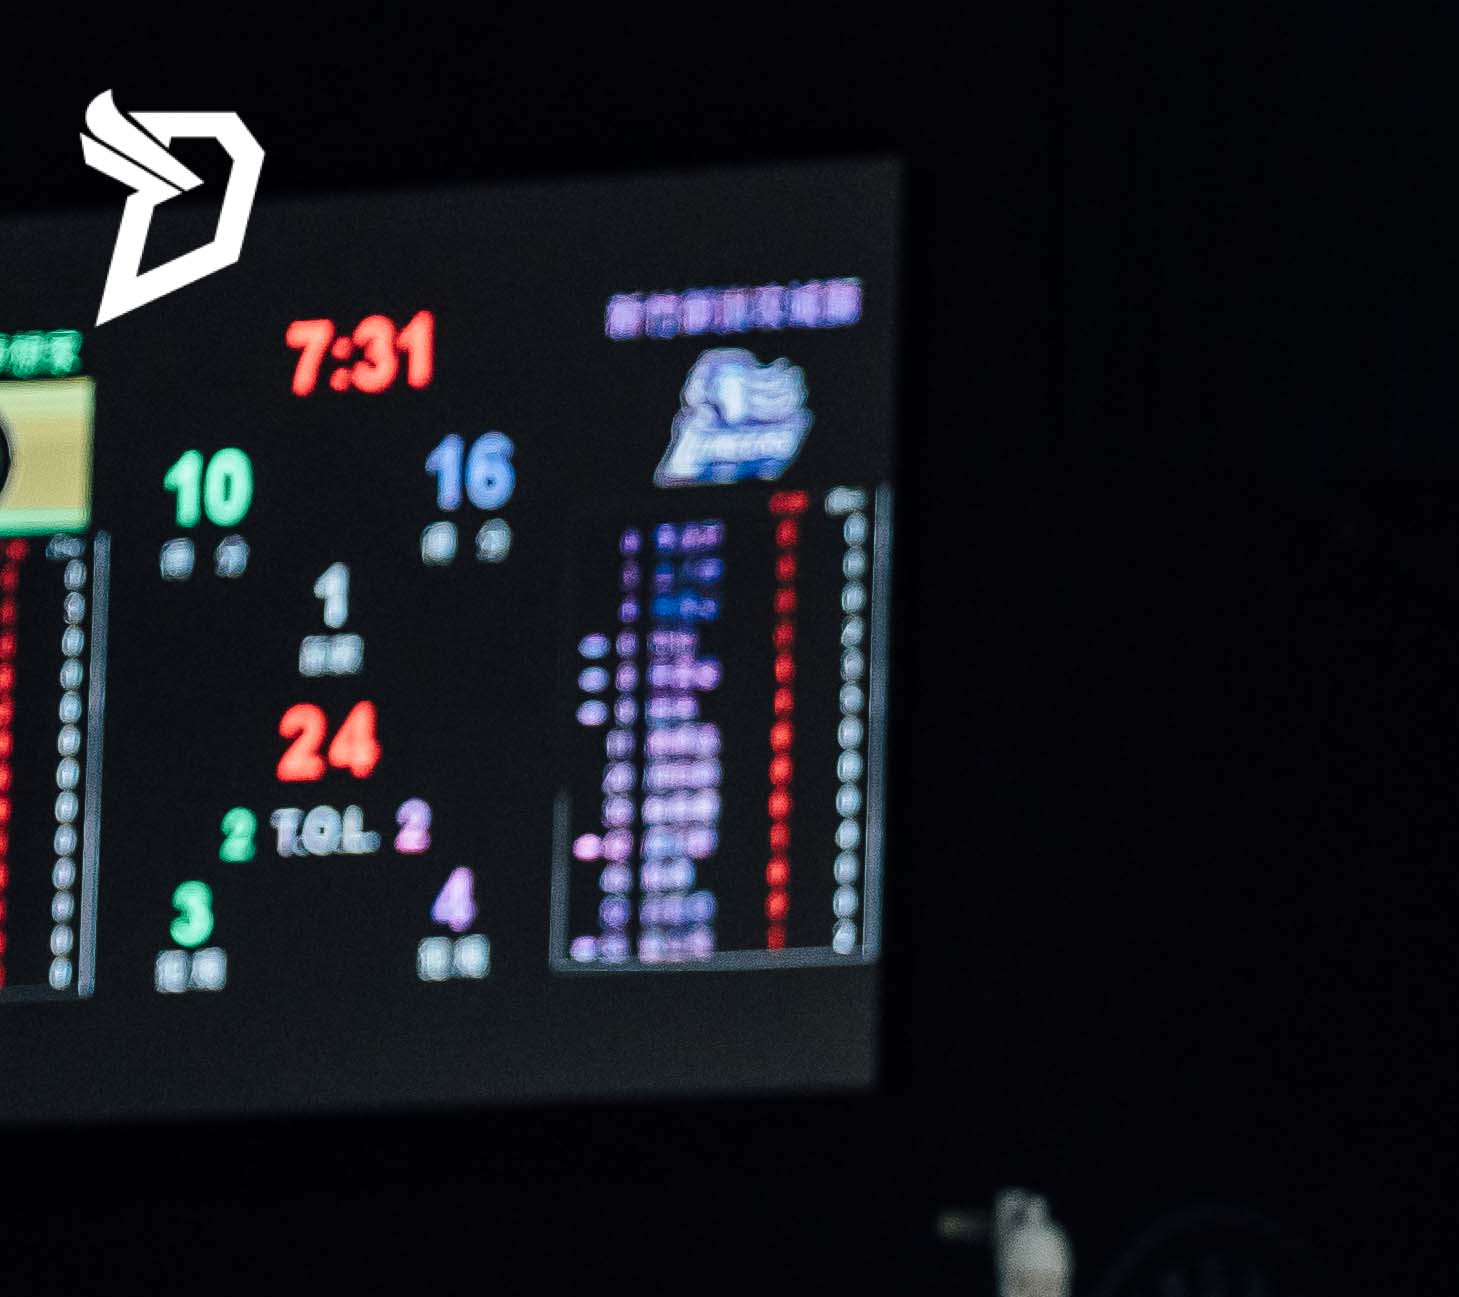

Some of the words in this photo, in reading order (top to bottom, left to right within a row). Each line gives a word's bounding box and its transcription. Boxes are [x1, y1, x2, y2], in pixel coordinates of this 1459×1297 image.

[287, 311, 436, 396] 7:31
[163, 446, 256, 528] 10
[424, 431, 518, 511] 16
[313, 561, 351, 630] 1
[275, 699, 384, 782] 24
[219, 806, 258, 863] 2
[393, 797, 433, 854] 2
[169, 880, 215, 948] 3
[429, 865, 479, 932] 4
